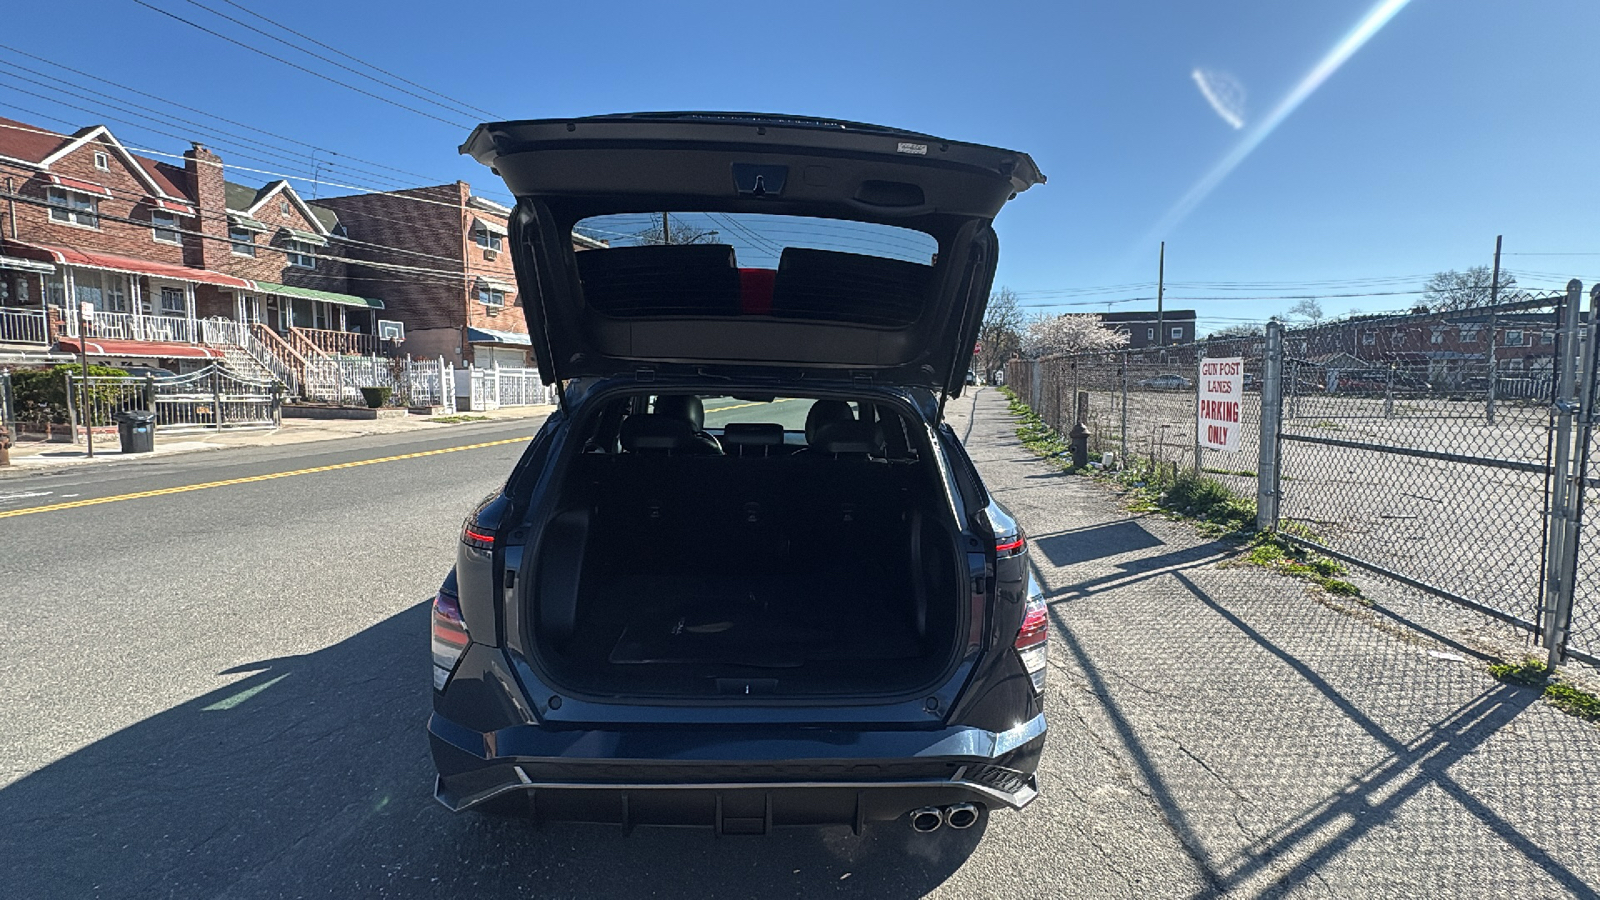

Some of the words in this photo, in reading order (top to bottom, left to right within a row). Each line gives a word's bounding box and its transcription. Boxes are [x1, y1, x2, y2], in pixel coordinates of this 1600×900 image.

[1202, 363, 1218, 376] GUN
[1220, 362, 1240, 376] POST
[1207, 380, 1232, 393] LANES
[1200, 399, 1239, 423] PARKING
[1207, 424, 1228, 446] ONLY
